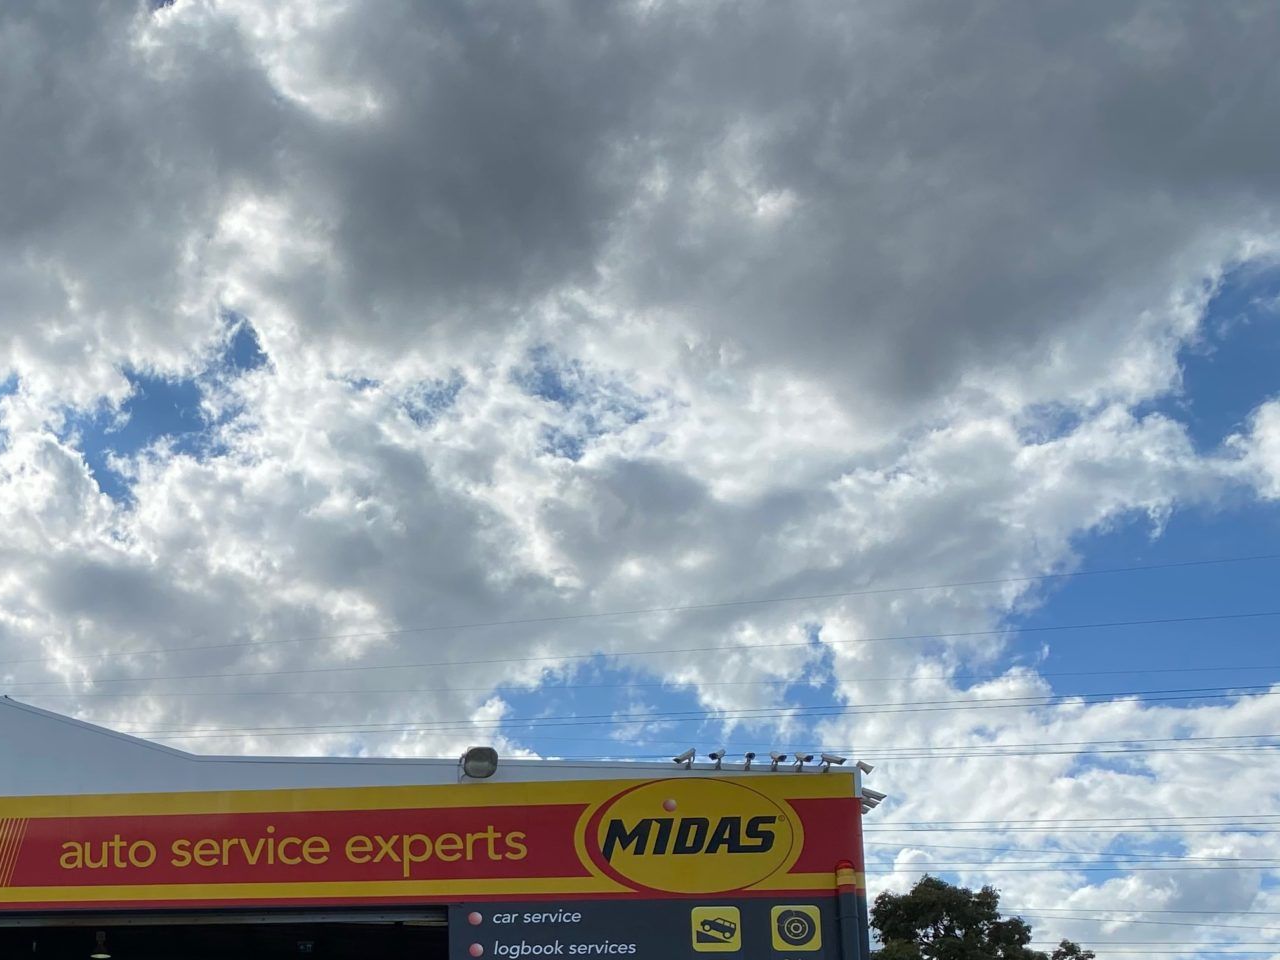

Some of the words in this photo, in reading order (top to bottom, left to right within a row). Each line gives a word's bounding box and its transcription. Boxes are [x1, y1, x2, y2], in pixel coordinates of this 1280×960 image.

[59, 834, 157, 869] auto
[170, 826, 330, 867] service
[344, 826, 528, 877] experts
[602, 815, 777, 865] MIDAS
[492, 913, 518, 924] car
[523, 909, 582, 923] service
[494, 940, 564, 959] logbook
[569, 940, 637, 955] services
